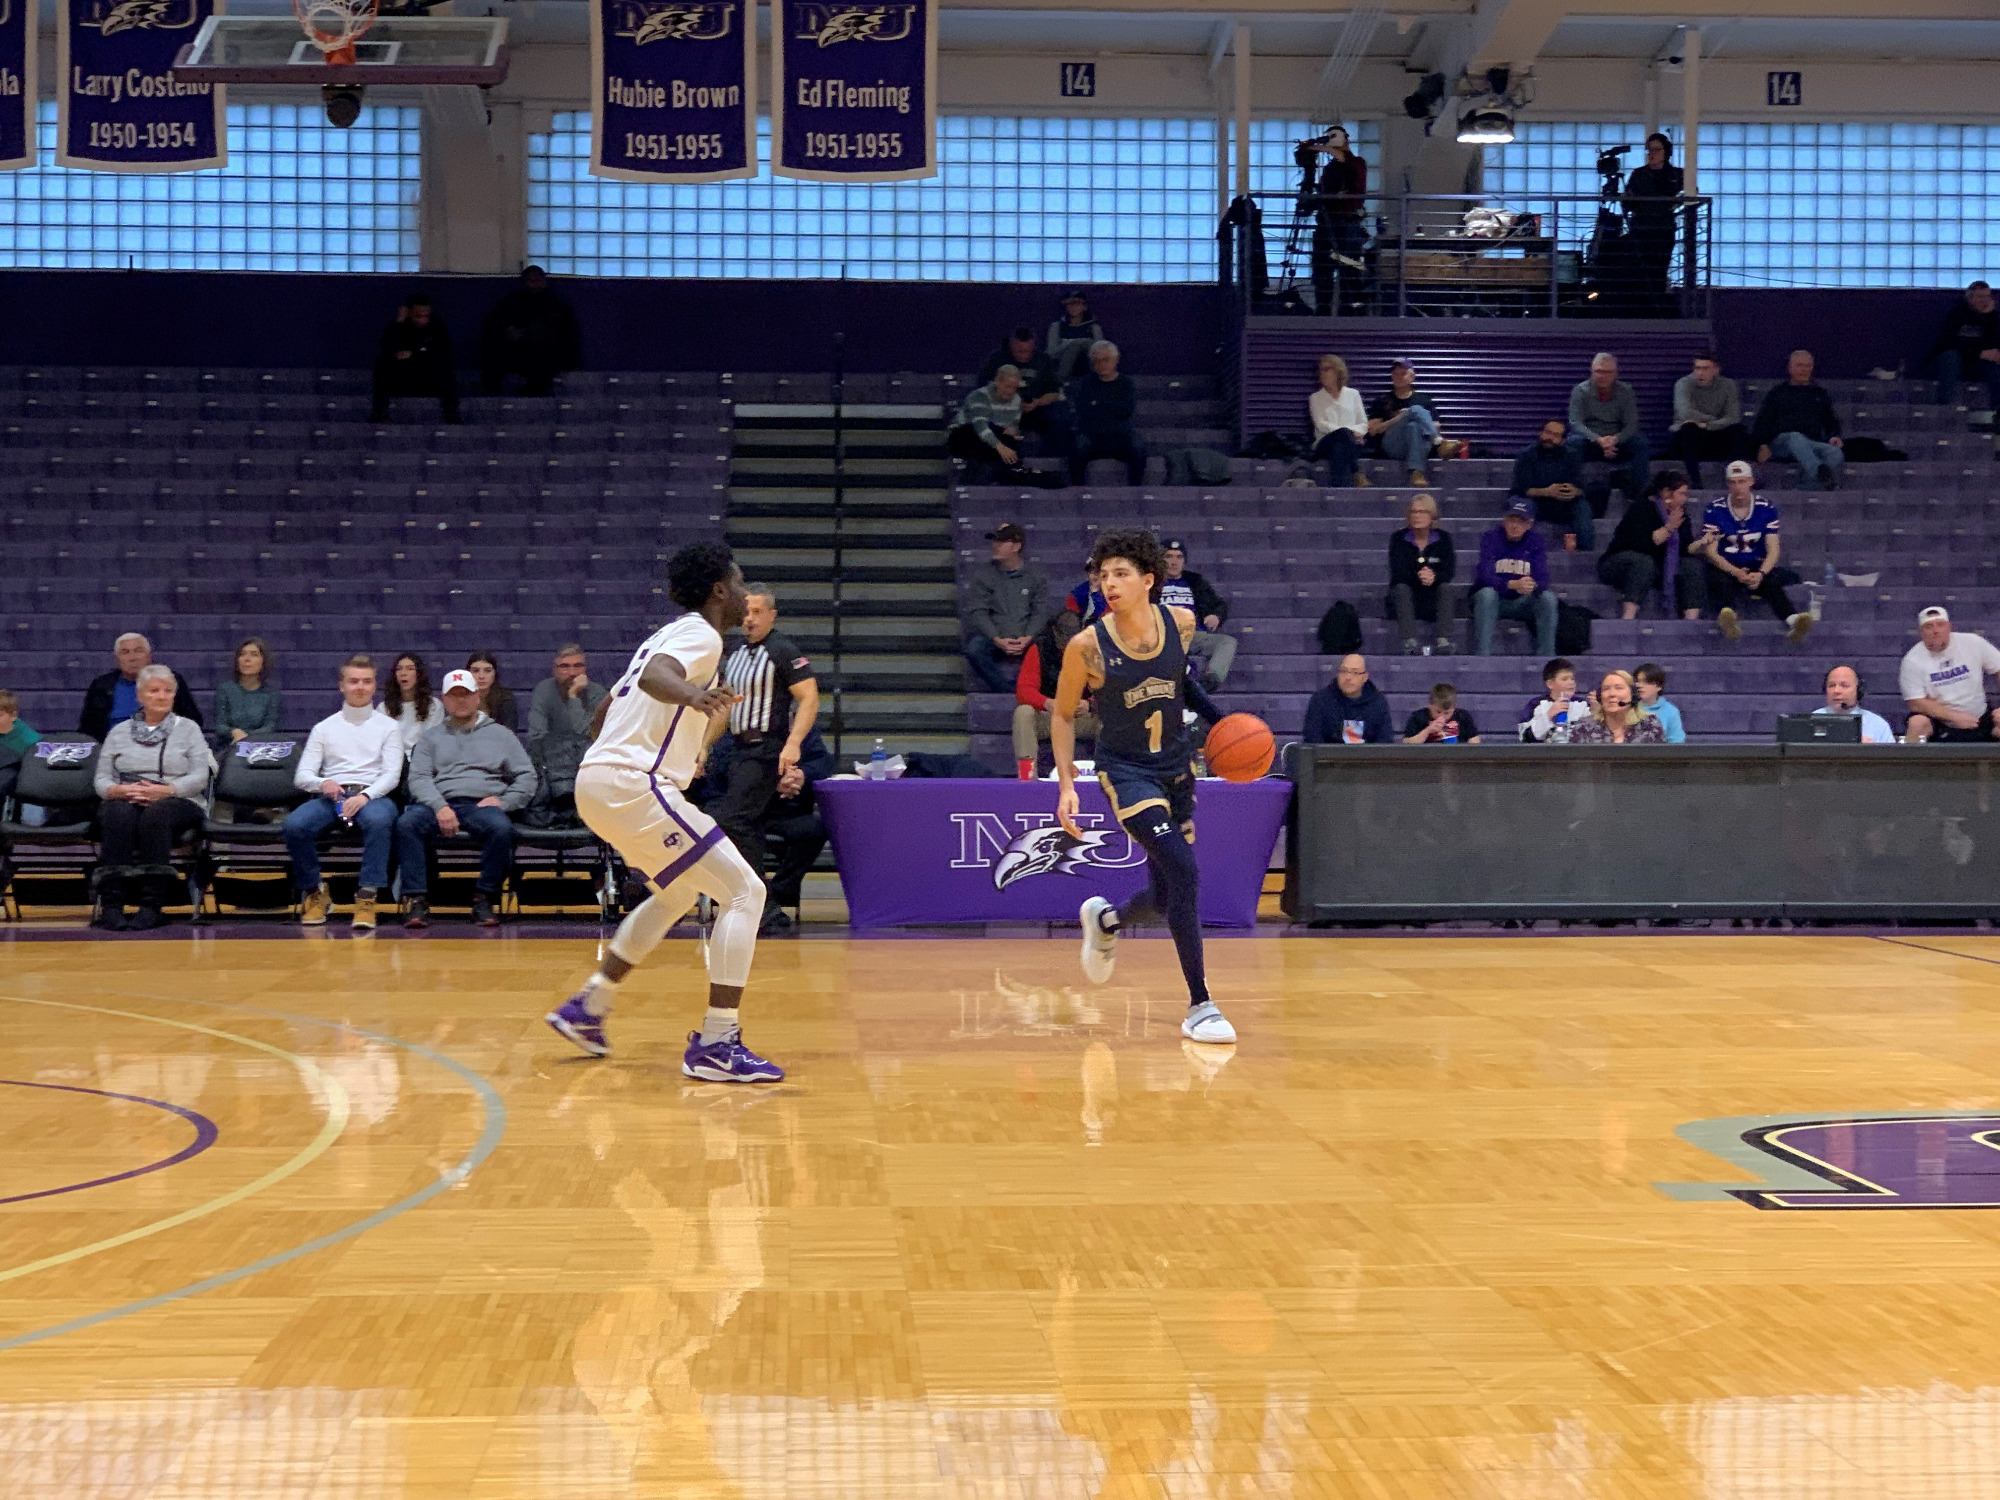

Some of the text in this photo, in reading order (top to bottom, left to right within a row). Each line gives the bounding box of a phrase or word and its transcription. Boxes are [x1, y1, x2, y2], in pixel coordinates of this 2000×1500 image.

[73, 65, 123, 102] Larry
[608, 76, 740, 108] Hubie Brown
[1066, 64, 1092, 95] 14
[1772, 73, 1798, 104] 14
[798, 78, 911, 113] Ed Fleming
[90, 121, 197, 148] 1950-1954
[625, 132, 723, 160] 1951-1955
[806, 131, 903, 159] 1951-1955
[452, 673, 463, 682] N
[1145, 710, 1163, 753] 1
